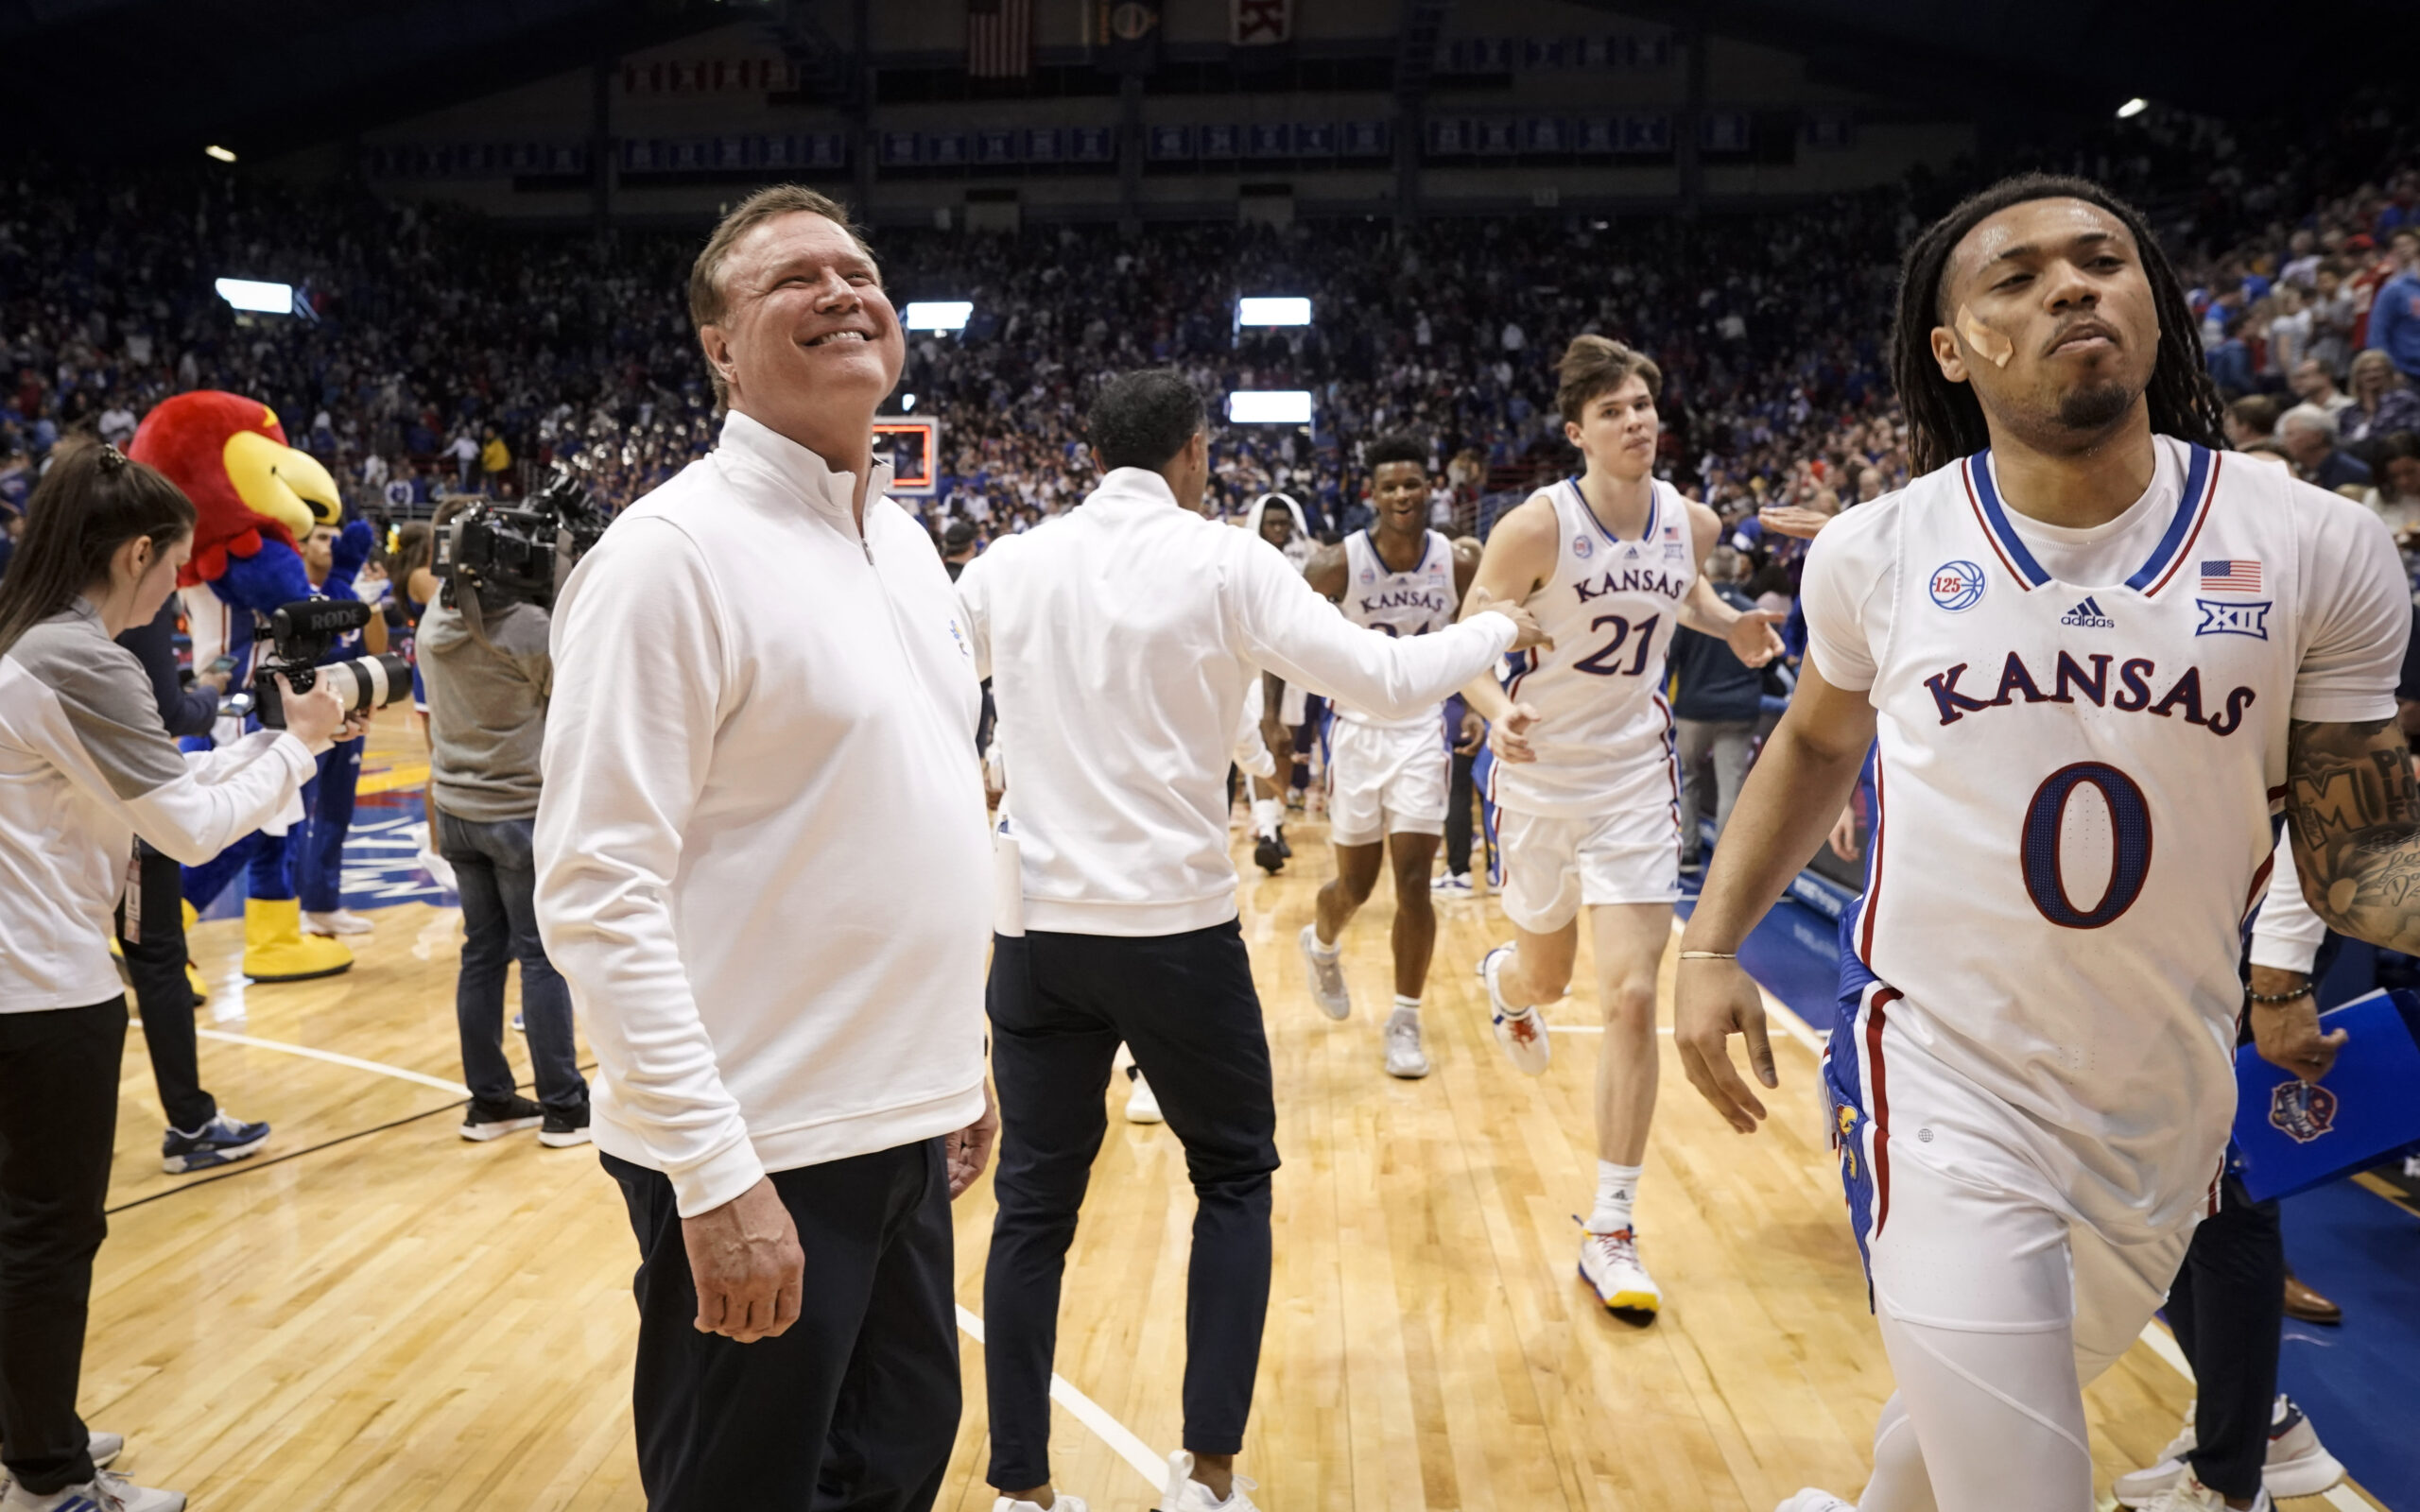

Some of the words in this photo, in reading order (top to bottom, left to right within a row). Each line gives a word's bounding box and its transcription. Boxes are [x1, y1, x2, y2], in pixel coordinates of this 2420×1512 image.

[1359, 590, 1444, 614] KANSAS
[1573, 569, 1684, 604] KANSAS
[1934, 577, 1962, 593] 125
[2060, 614, 2115, 628] adidas
[1572, 612, 1661, 677] 21
[1923, 650, 2256, 737] KANSAS
[2020, 761, 2153, 930] 0
